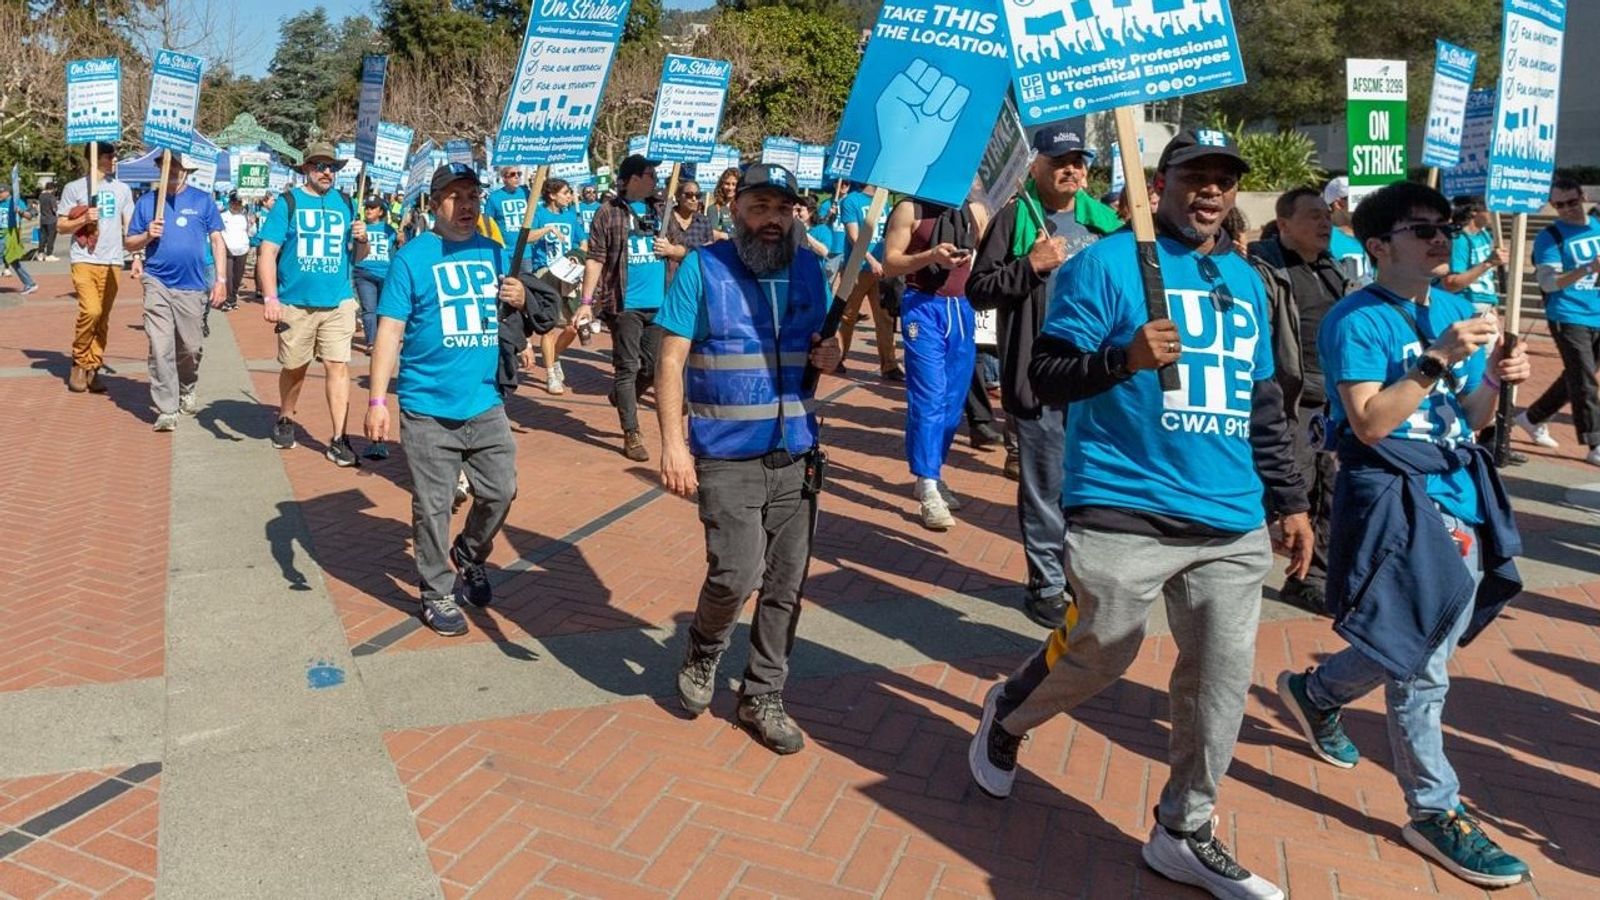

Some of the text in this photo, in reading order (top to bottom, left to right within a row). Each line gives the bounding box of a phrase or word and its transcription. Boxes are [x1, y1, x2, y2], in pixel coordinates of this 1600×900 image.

[568, 0, 627, 20] Strike!
[884, 5, 998, 35] TAKE THIS
[876, 24, 909, 40] THE
[546, 45, 561, 54] FOR
[1046, 35, 1228, 82] University Professional
[572, 64, 602, 72] RESEARCH
[668, 59, 729, 76] On Strike!
[1050, 51, 1231, 96] & Technical Employees
[1022, 76, 1041, 87] UP
[1352, 78, 1383, 93] AFSCME
[1023, 86, 1043, 99] TE
[1199, 130, 1223, 138] UP
[1368, 110, 1389, 141] ON
[838, 141, 858, 157] UP
[835, 155, 855, 170] TE
[1352, 144, 1403, 176] STRIKE
[504, 201, 526, 213] UP
[299, 211, 342, 232] UP
[299, 234, 342, 257] TE
[437, 264, 494, 296] UP
[443, 297, 497, 331] TE
[1167, 294, 1256, 352] UP
[443, 336, 478, 348] CWA
[1178, 352, 1252, 411] TE
[1161, 412, 1250, 438] CWA 911
